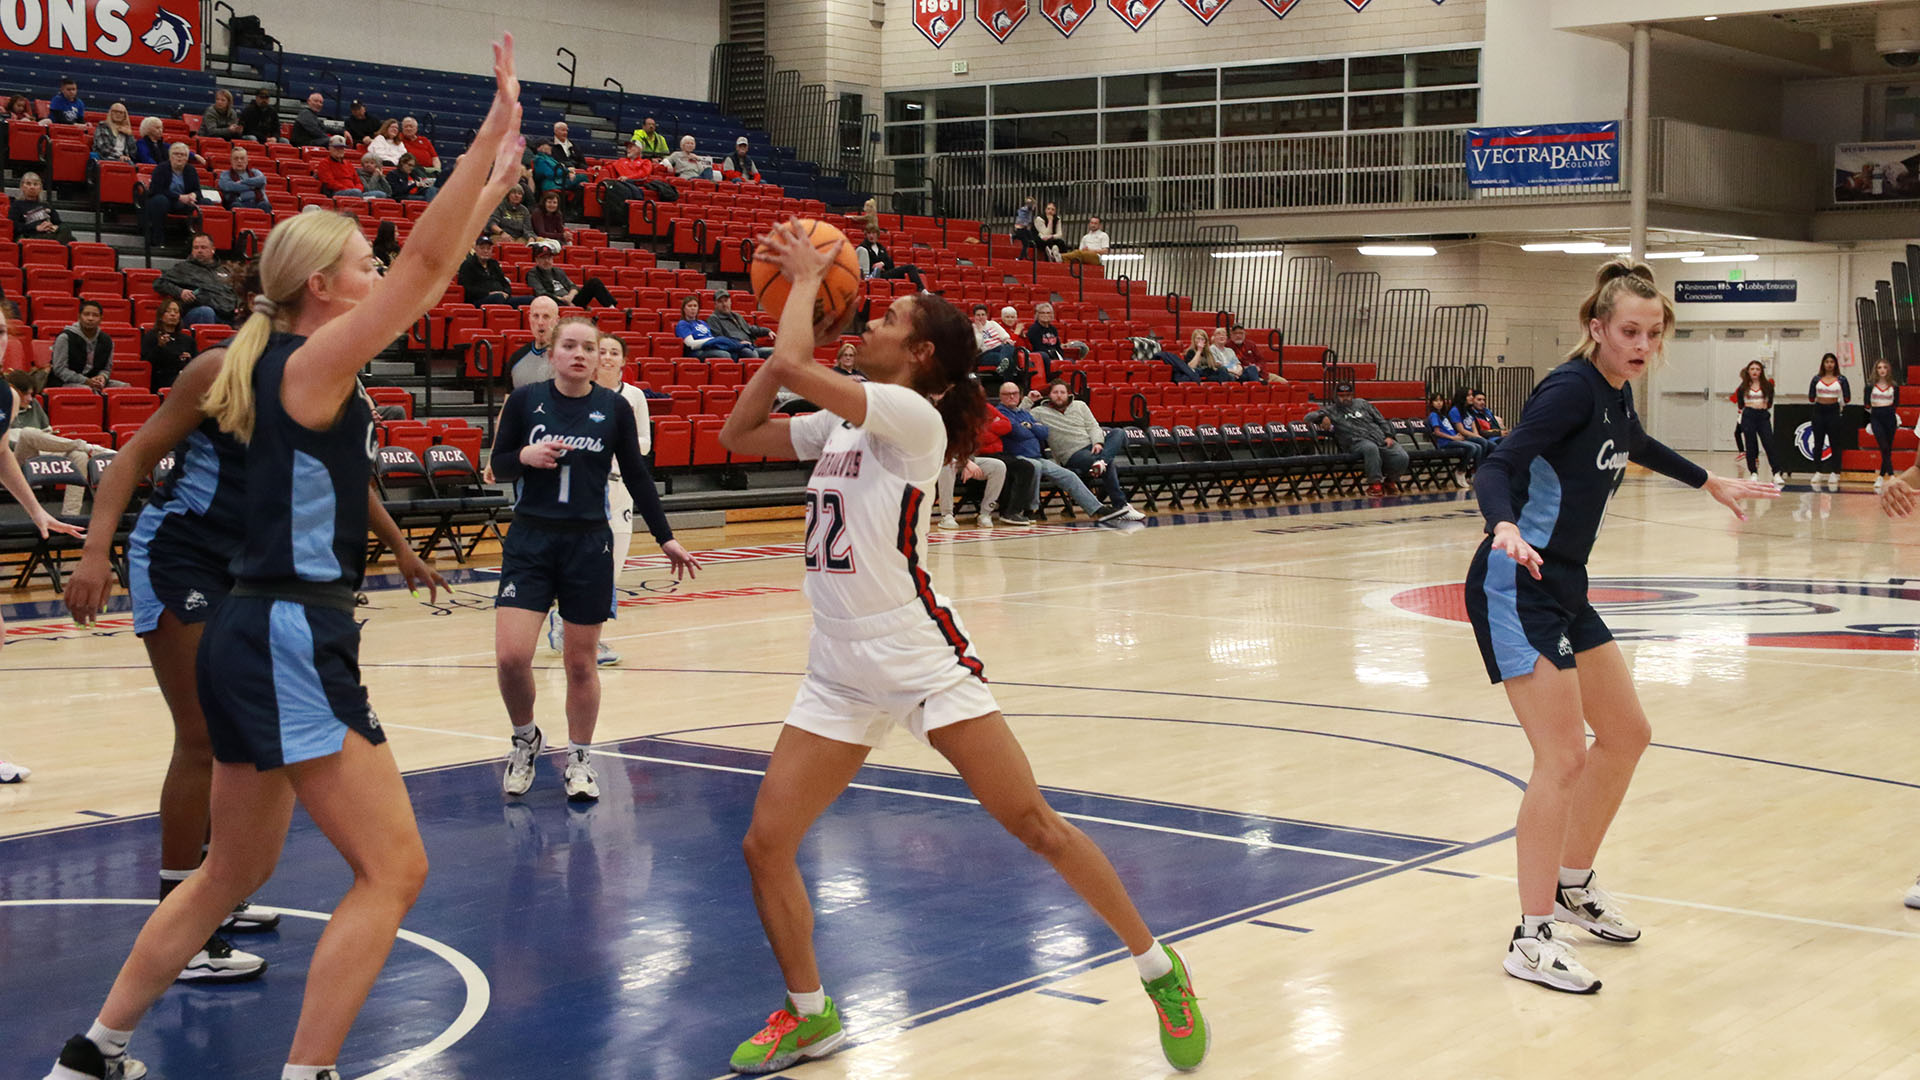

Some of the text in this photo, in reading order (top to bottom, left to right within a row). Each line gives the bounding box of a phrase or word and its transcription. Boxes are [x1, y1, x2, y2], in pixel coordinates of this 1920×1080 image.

[920, 0, 958, 13] 1961
[0, 0, 133, 56] ONS
[1565, 160, 1611, 169] COLORADO
[1684, 283, 1795, 291] Restrooms Lobby/Entrance
[1684, 292, 1723, 300] Concessions
[1176, 428, 1195, 437] PACK
[1200, 427, 1219, 436] PACK
[1225, 426, 1243, 435] PACK
[1247, 425, 1265, 434] PACK
[1269, 424, 1287, 433] PACK
[1291, 424, 1308, 432] PACK
[1127, 429, 1145, 438] PACK
[1151, 429, 1171, 437] PACK
[381, 451, 415, 463] PACK
[430, 450, 464, 462] PACK
[29, 460, 75, 474] PACK
[159, 457, 176, 470] PA
[558, 465, 571, 503] 1
[806, 488, 857, 574] 22
